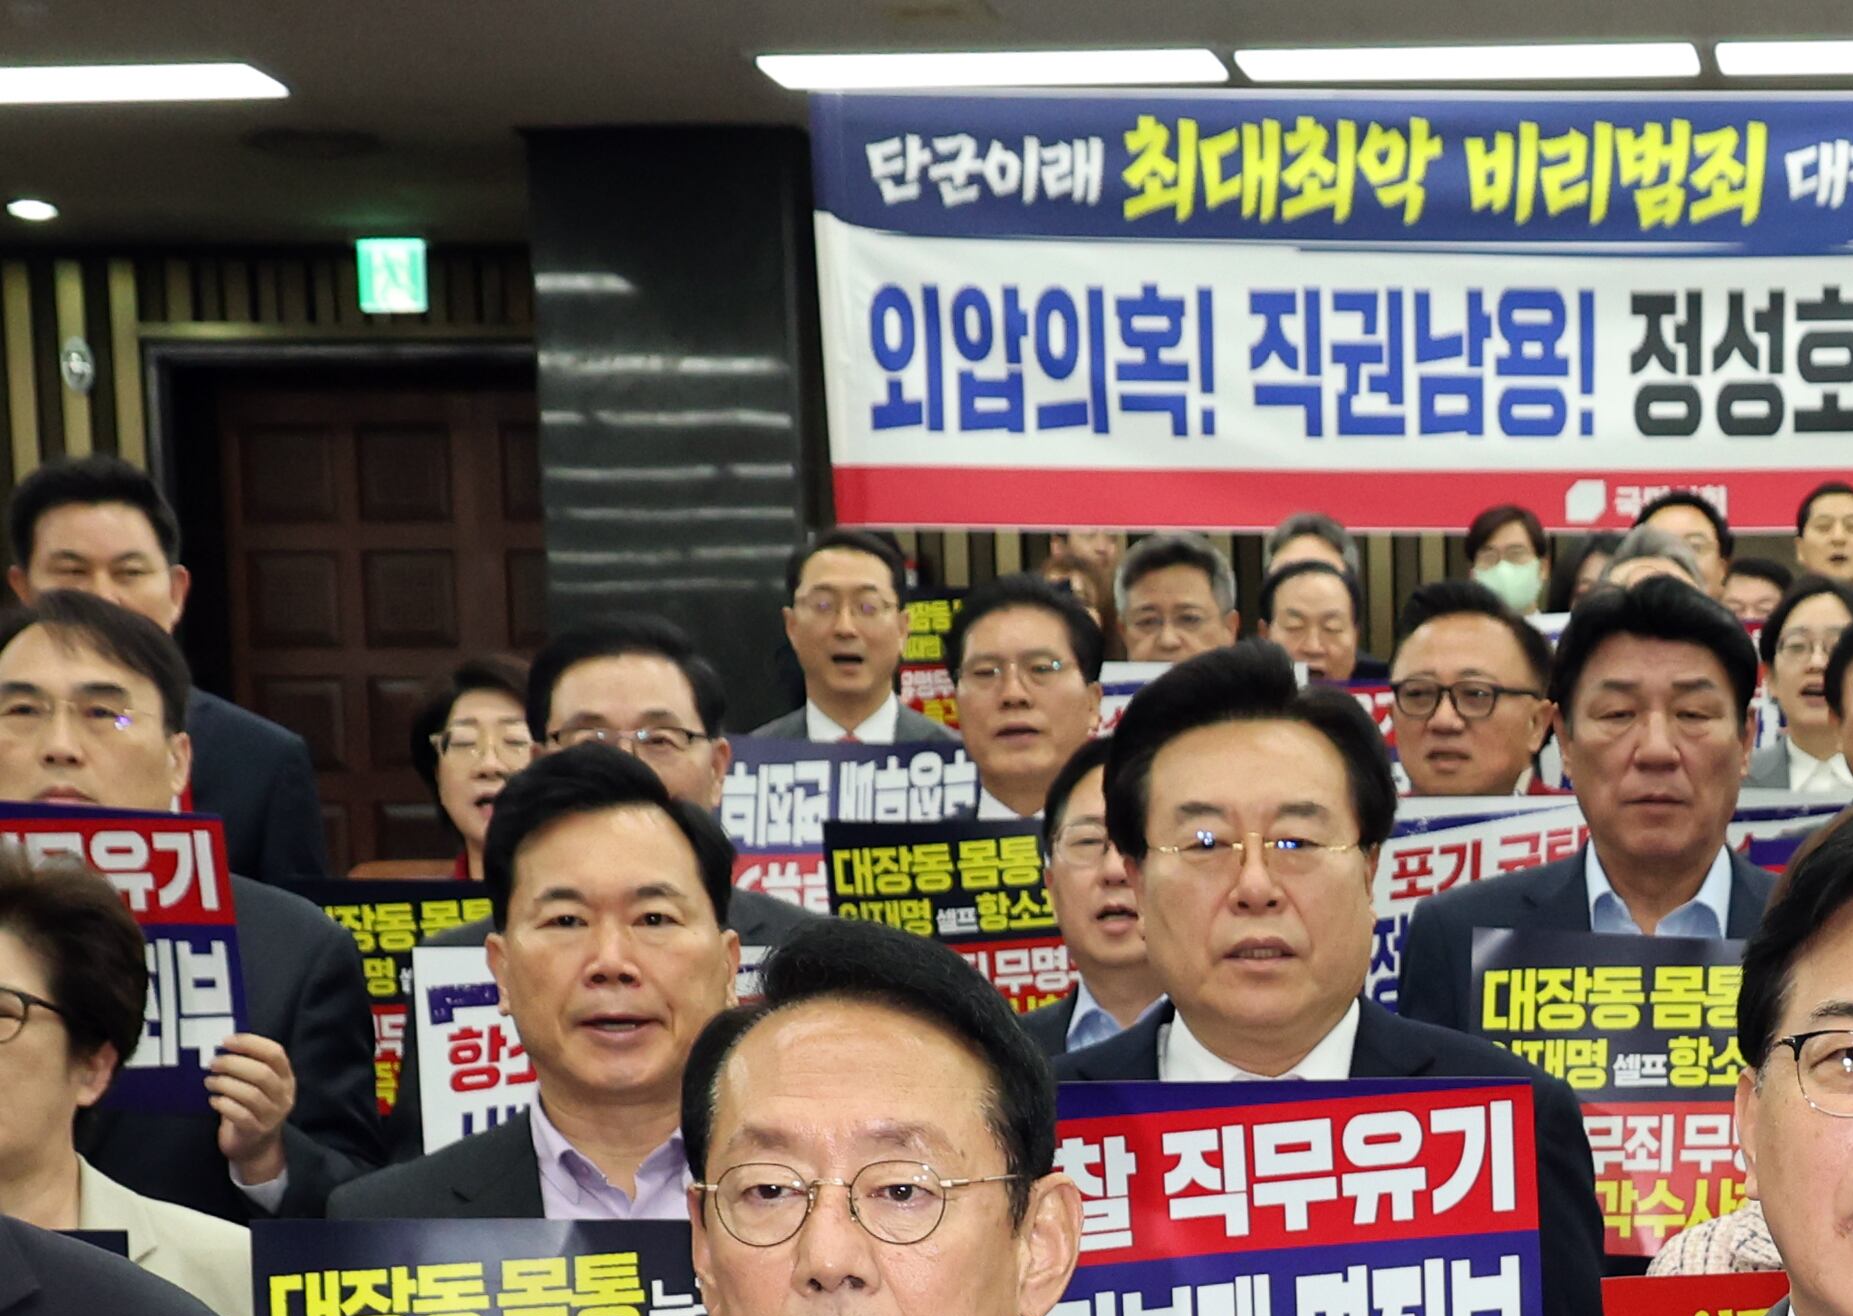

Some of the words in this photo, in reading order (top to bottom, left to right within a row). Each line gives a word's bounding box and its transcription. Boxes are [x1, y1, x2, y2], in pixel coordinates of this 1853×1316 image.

[865, 134, 1103, 206] 단군이래
[1121, 115, 1442, 225] 최대최악
[1466, 119, 1767, 229] 비리범죄
[870, 283, 1215, 437] 외압의혹!
[1250, 286, 1594, 438] 직권남용!
[833, 843, 954, 897] 대장동
[958, 835, 1042, 889] 몸통
[1482, 966, 1645, 1032] 대장동
[1612, 1052, 1669, 1087] 셀프
[1162, 1099, 1516, 1238] 직무유기
